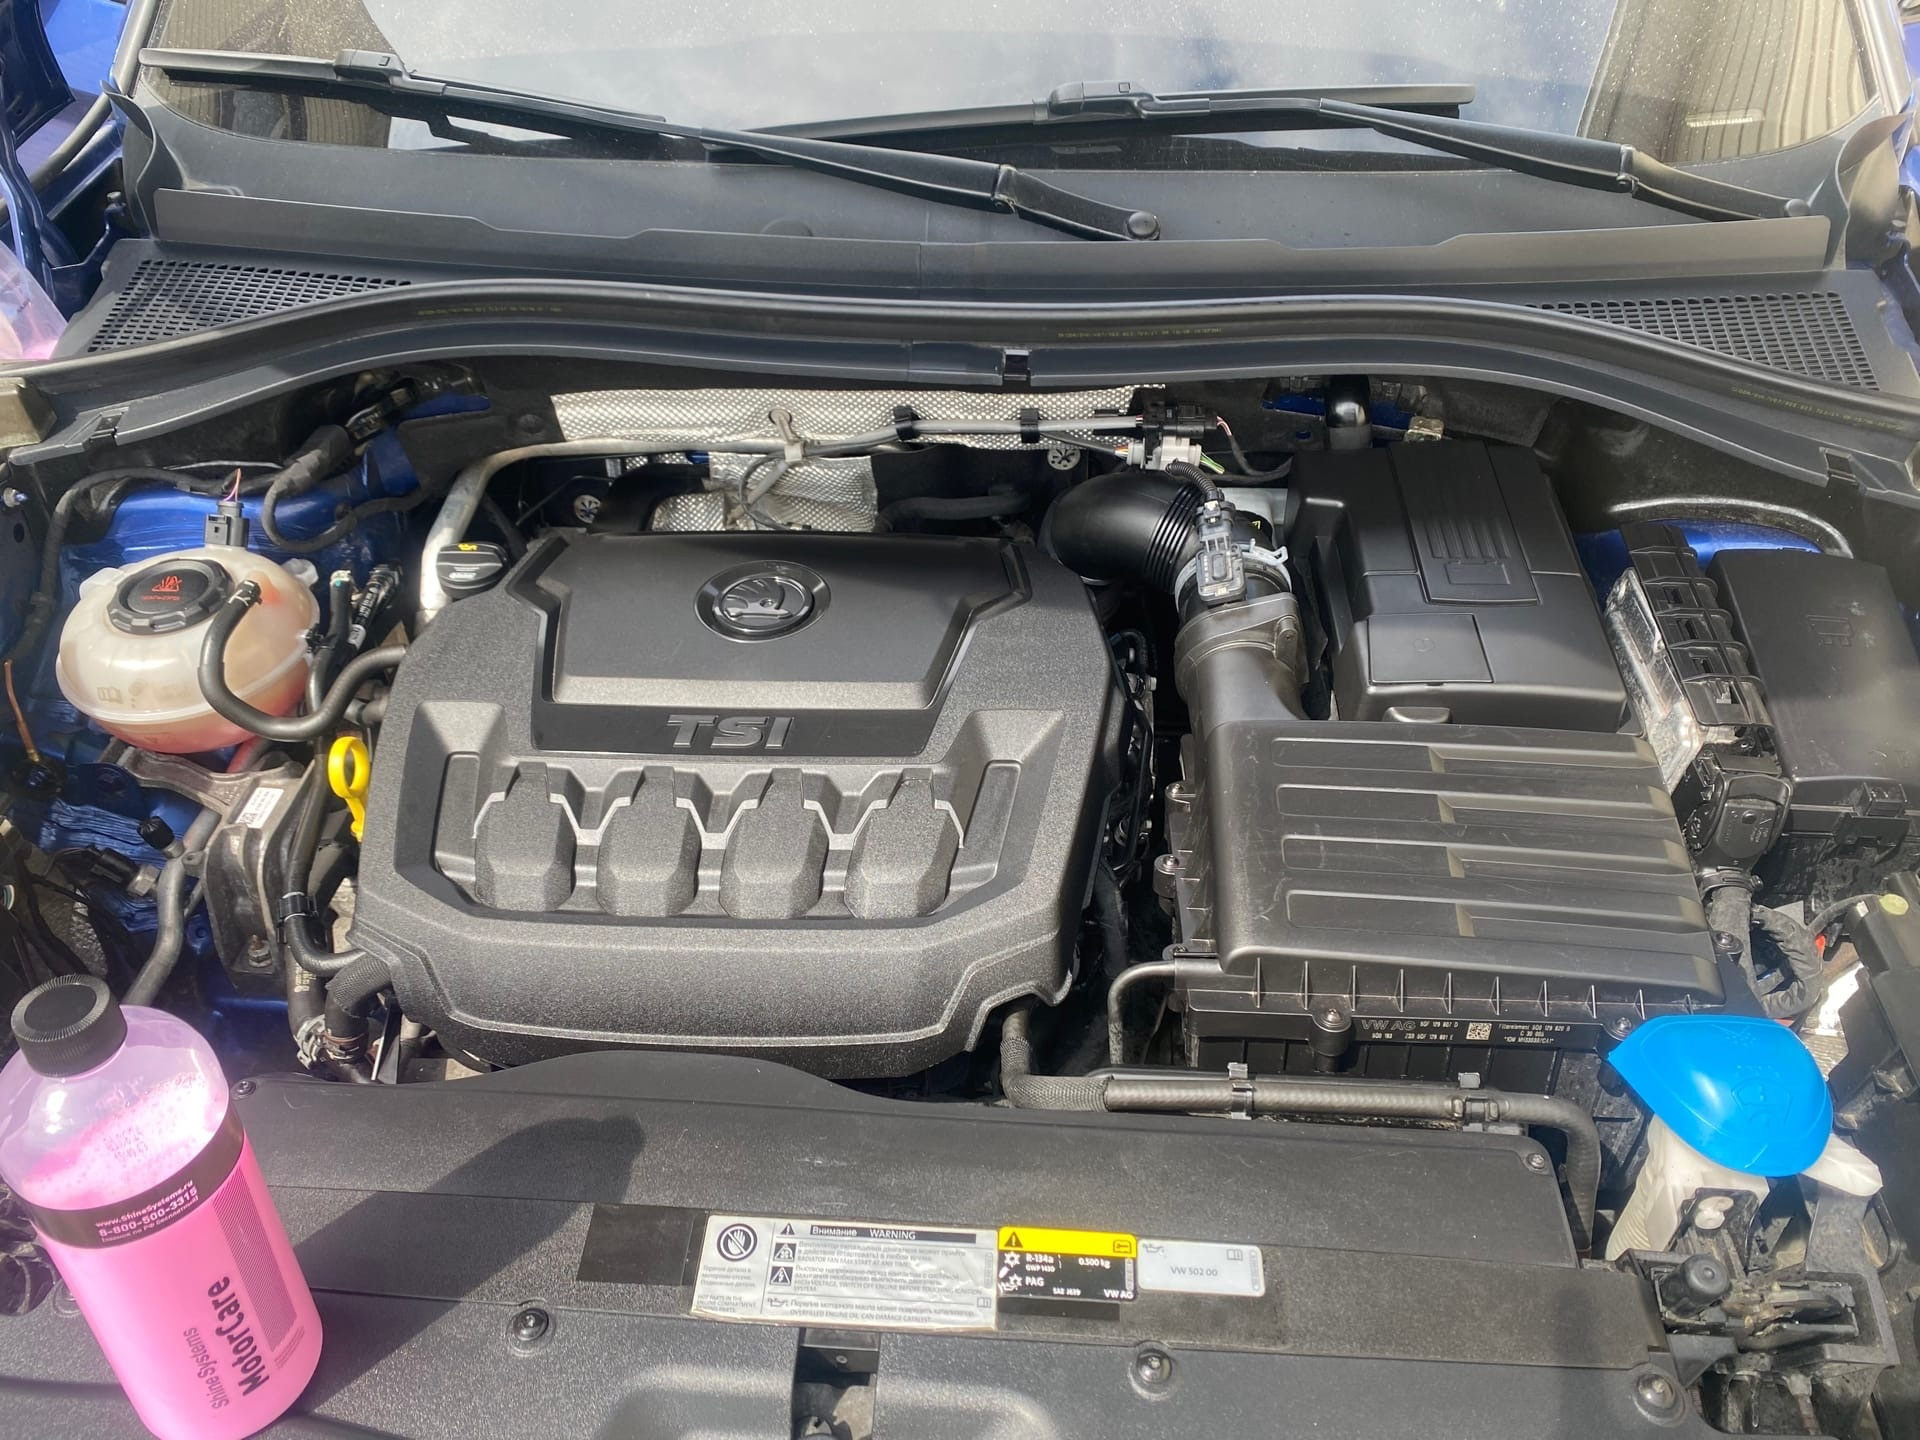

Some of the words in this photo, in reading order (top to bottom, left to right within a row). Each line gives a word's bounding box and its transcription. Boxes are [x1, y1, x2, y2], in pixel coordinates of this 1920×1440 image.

[667, 714, 795, 750] TSI
[1361, 1020, 1389, 1031] VW
[1391, 1020, 1416, 1031] AG
[99, 1185, 198, 1237] 8-800-500-3315
[812, 1225, 858, 1237] Внимание
[869, 1228, 916, 1241] WARNING
[1025, 1253, 1054, 1264] R-134a
[1170, 1266, 1186, 1275] VW
[1188, 1267, 1204, 1276] 502
[1206, 1268, 1218, 1277] 00
[1025, 1276, 1045, 1287] PAG
[1103, 1289, 1119, 1298] VW
[1119, 1291, 1134, 1300] AG
[207, 1276, 270, 1397] MotorCare
